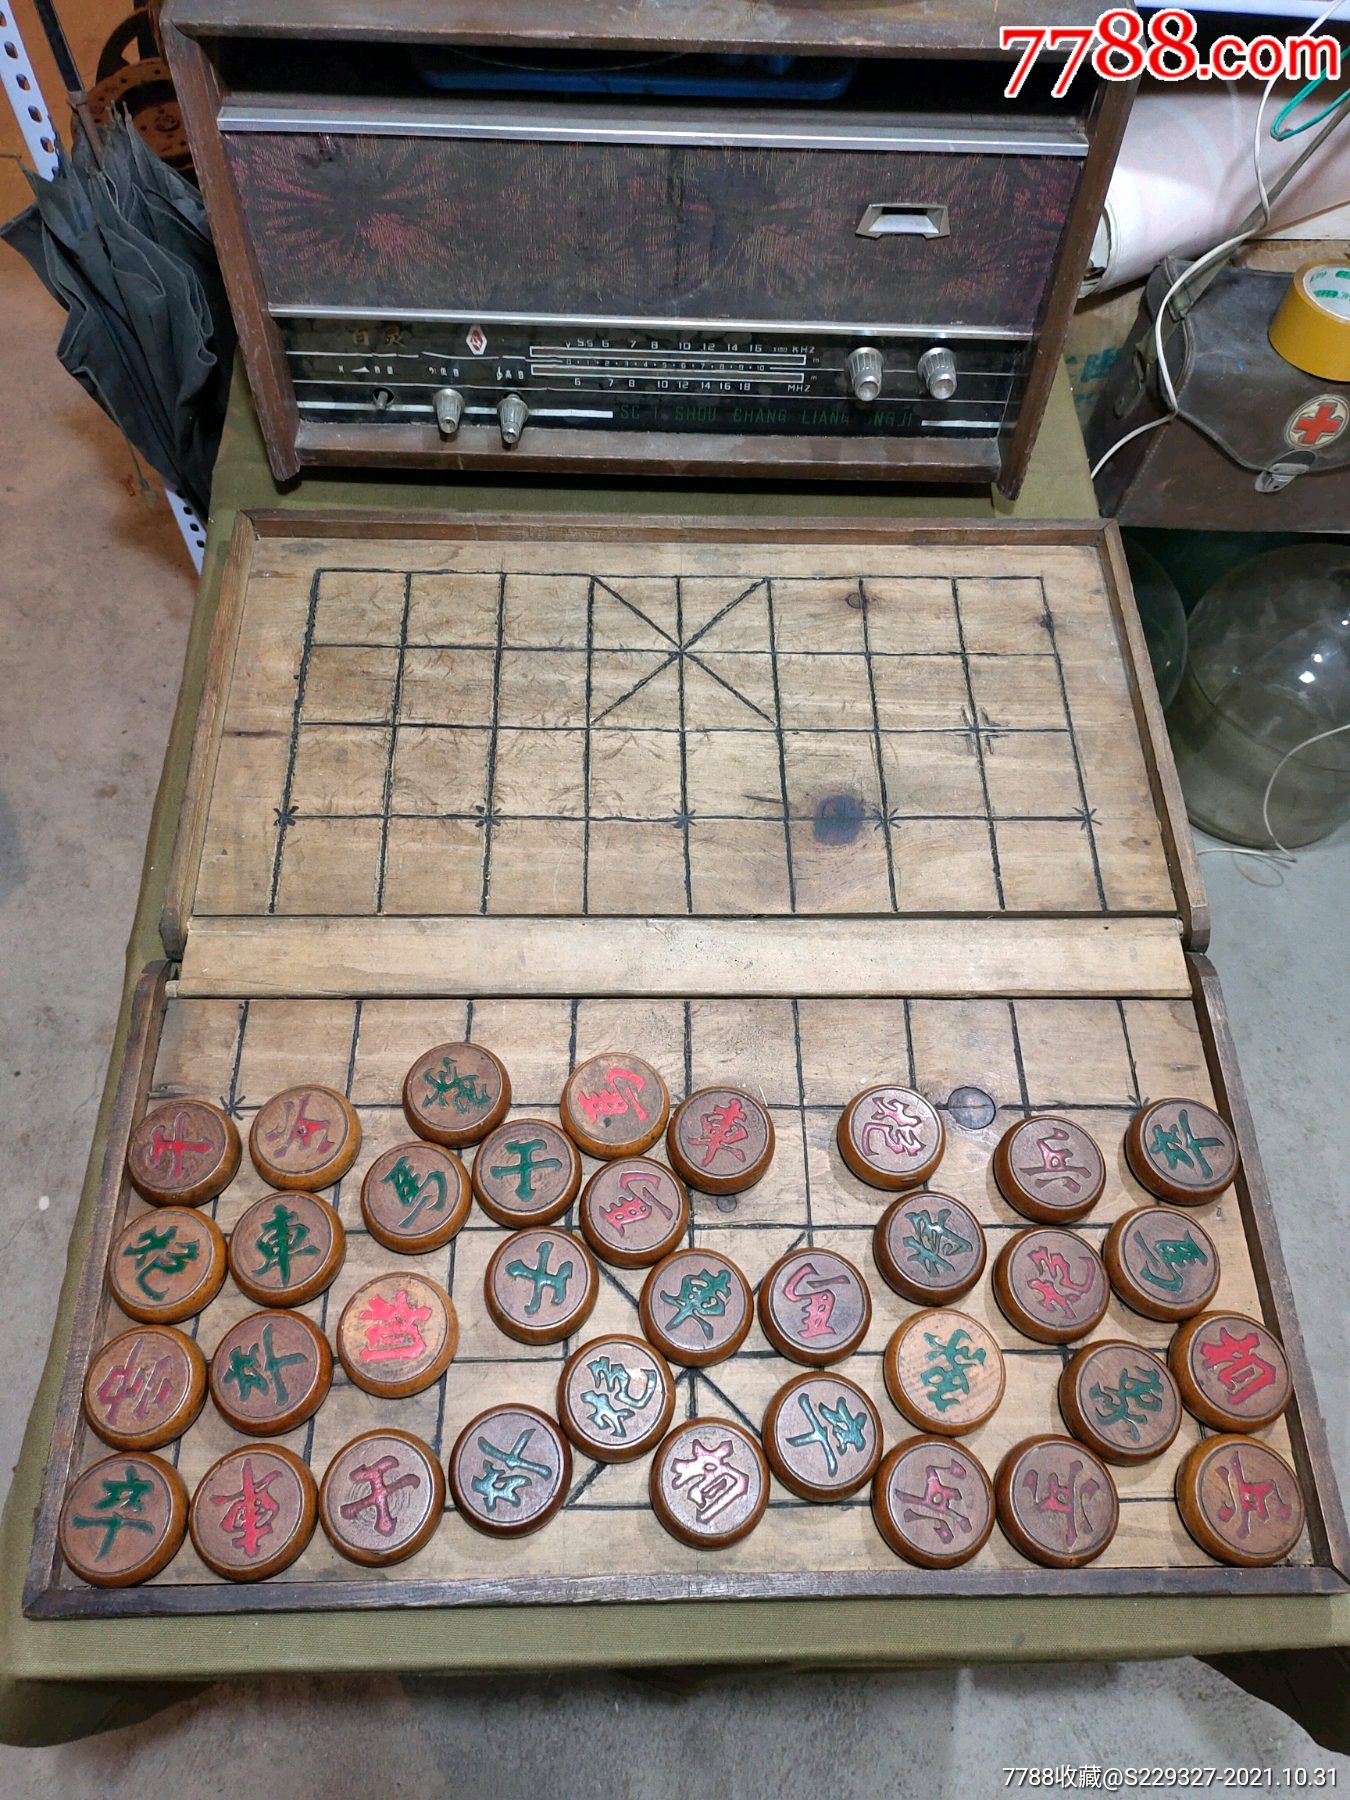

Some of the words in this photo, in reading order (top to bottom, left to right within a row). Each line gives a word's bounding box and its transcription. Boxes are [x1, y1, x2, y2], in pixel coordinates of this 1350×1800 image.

[602, 339, 609, 348] 6
[630, 340, 637, 348] 7
[651, 341, 658, 349] 8
[679, 341, 691, 350] 10
[703, 342, 715, 351] 12
[727, 343, 738, 352] 14
[749, 344, 762, 353] 16
[575, 378, 581, 386] 6
[608, 379, 614, 387] 7
[628, 380, 635, 388] 8
[657, 380, 668, 389] 10
[678, 381, 689, 389] 12
[701, 382, 711, 390] 14
[719, 382, 731, 391] 16
[739, 383, 751, 391] 18
[675, 407, 717, 423] SHOU
[733, 407, 788, 424] CHANG
[802, 408, 849, 426] LIANG
[265, 1093, 335, 1159] 兵
[1021, 1127, 1092, 1193] 兵
[894, 1458, 972, 1544] 兵
[1022, 1458, 1101, 1548] 兵
[1217, 1451, 1292, 1540] 兵
